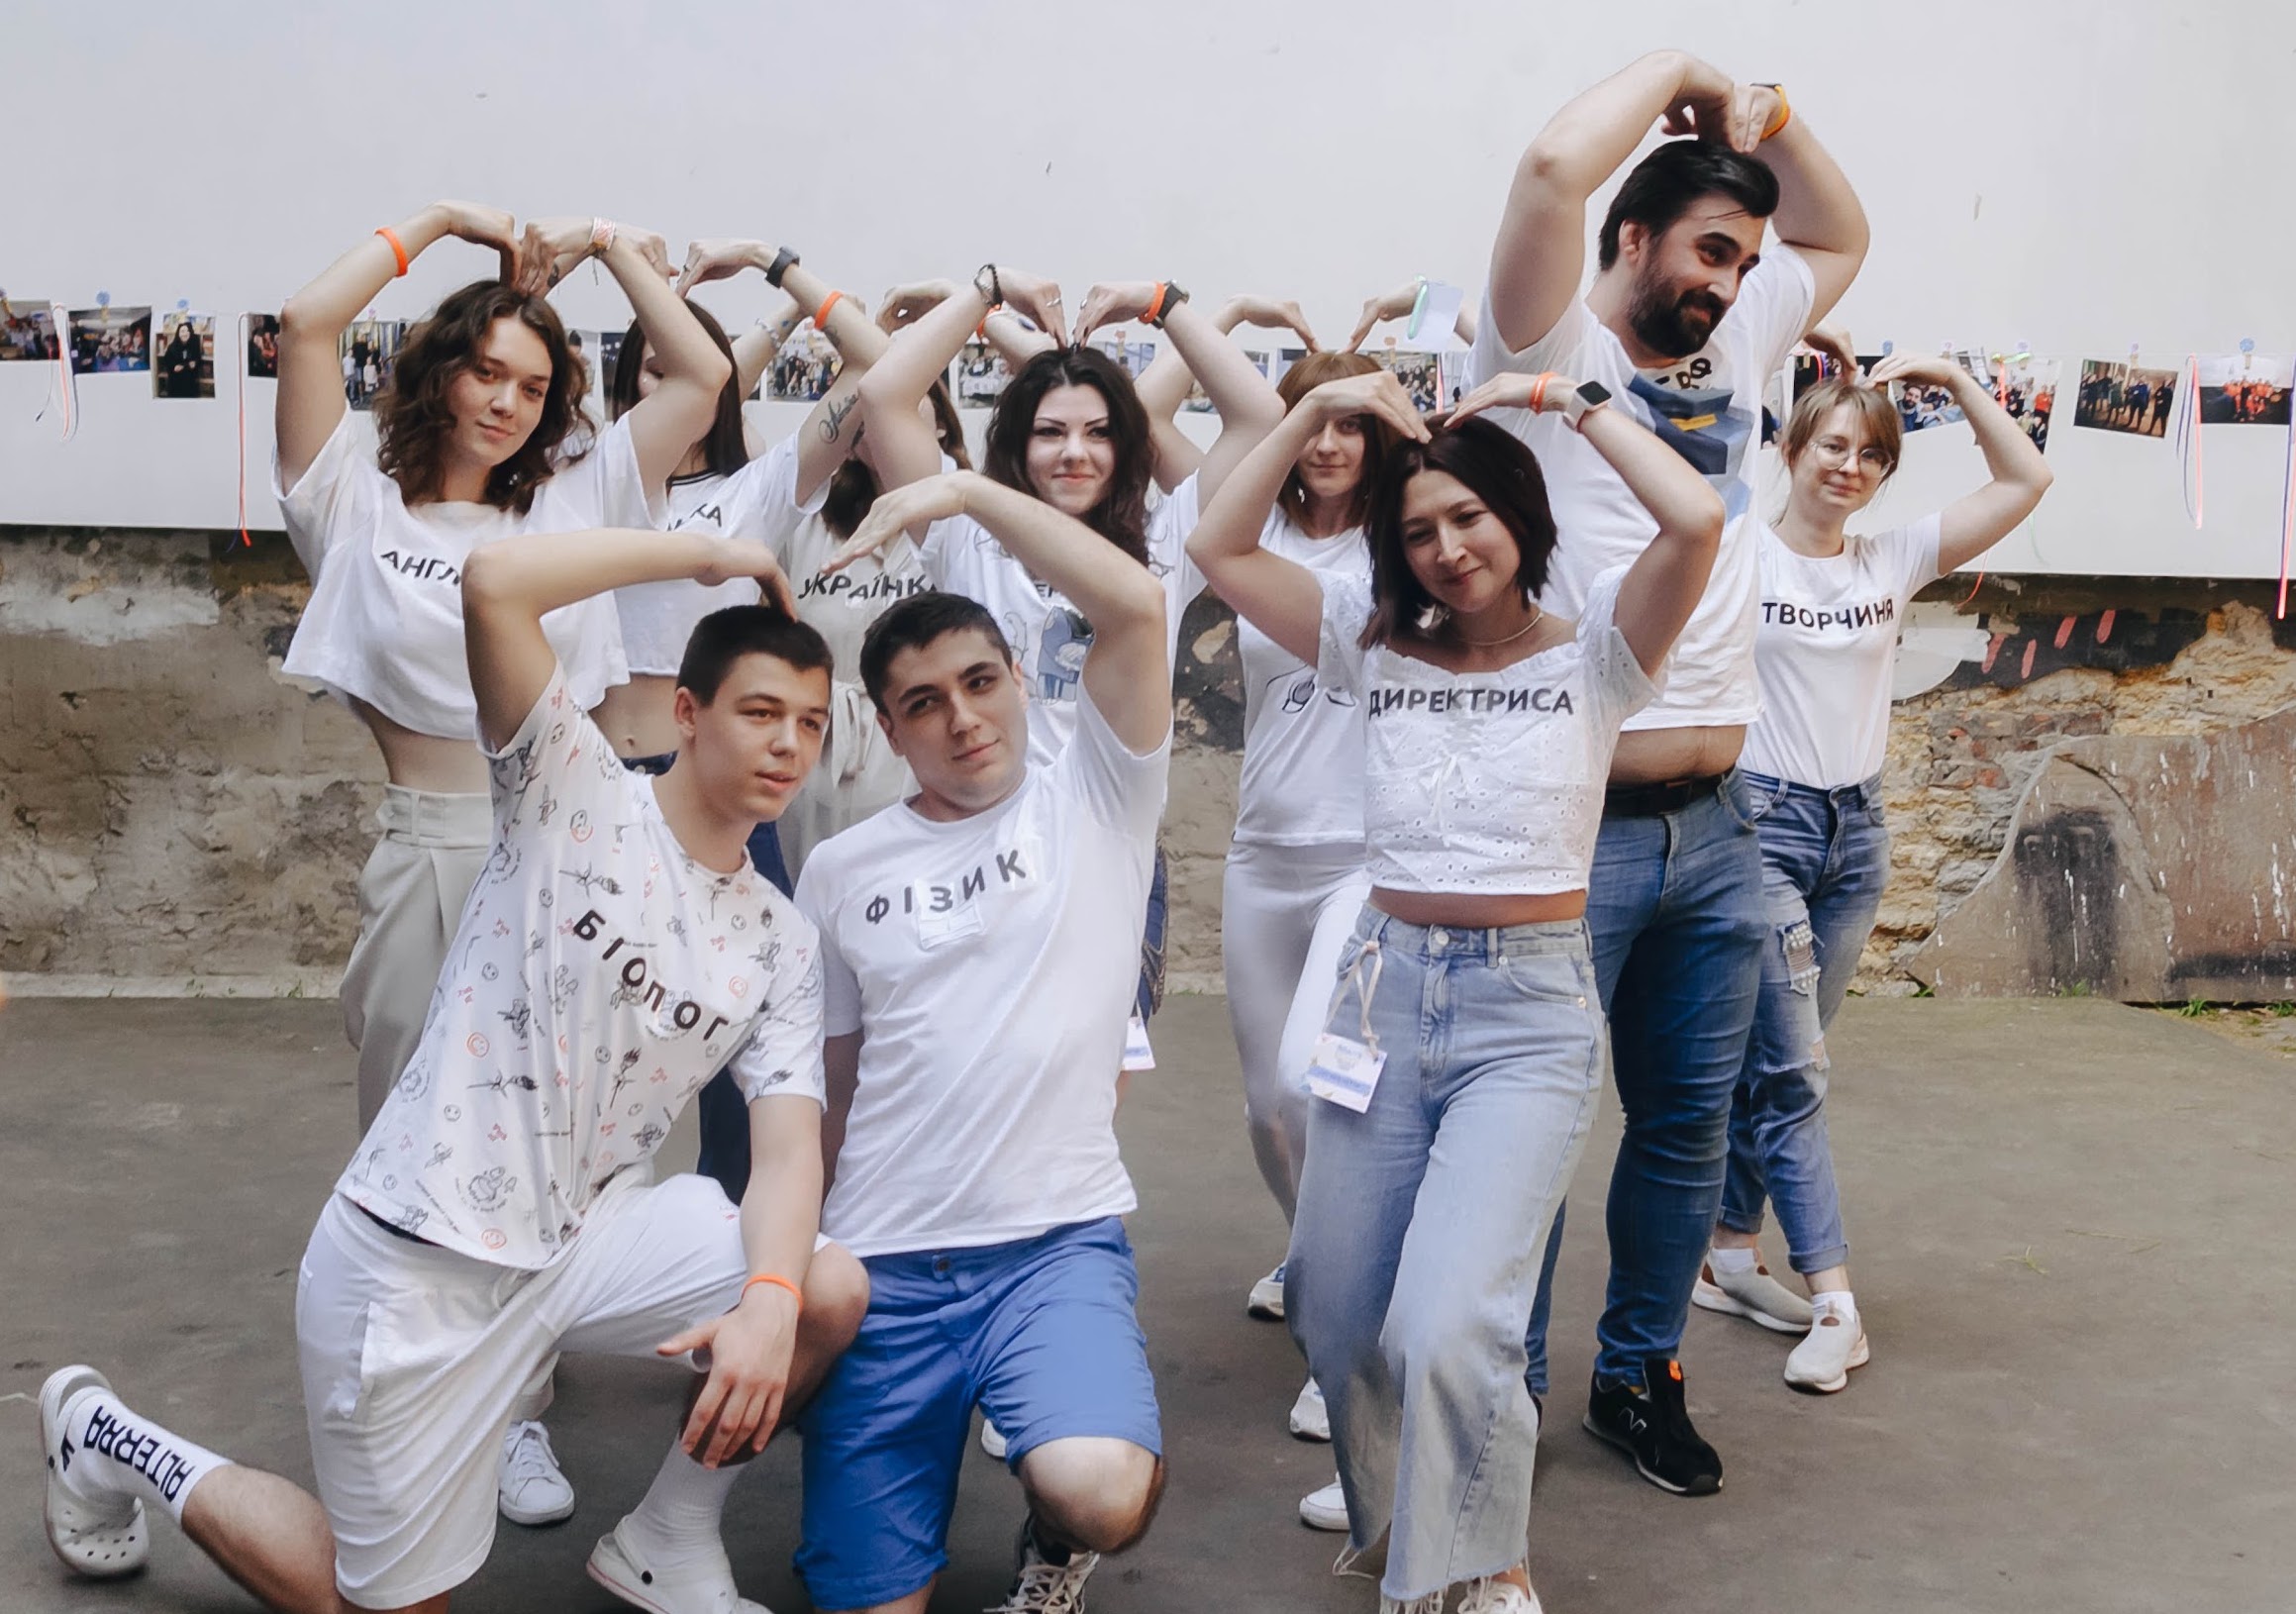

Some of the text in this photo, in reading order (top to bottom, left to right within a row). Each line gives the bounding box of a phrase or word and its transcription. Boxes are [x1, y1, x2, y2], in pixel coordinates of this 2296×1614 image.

[797, 571, 938, 600] УКРАЇНК
[1760, 598, 1894, 631] ТВОРЧИНЯ
[1367, 687, 1574, 721] ДИРЕКТРИСА
[864, 849, 1027, 926] ФІЗИК
[83, 1405, 196, 1503] ALTERRA
